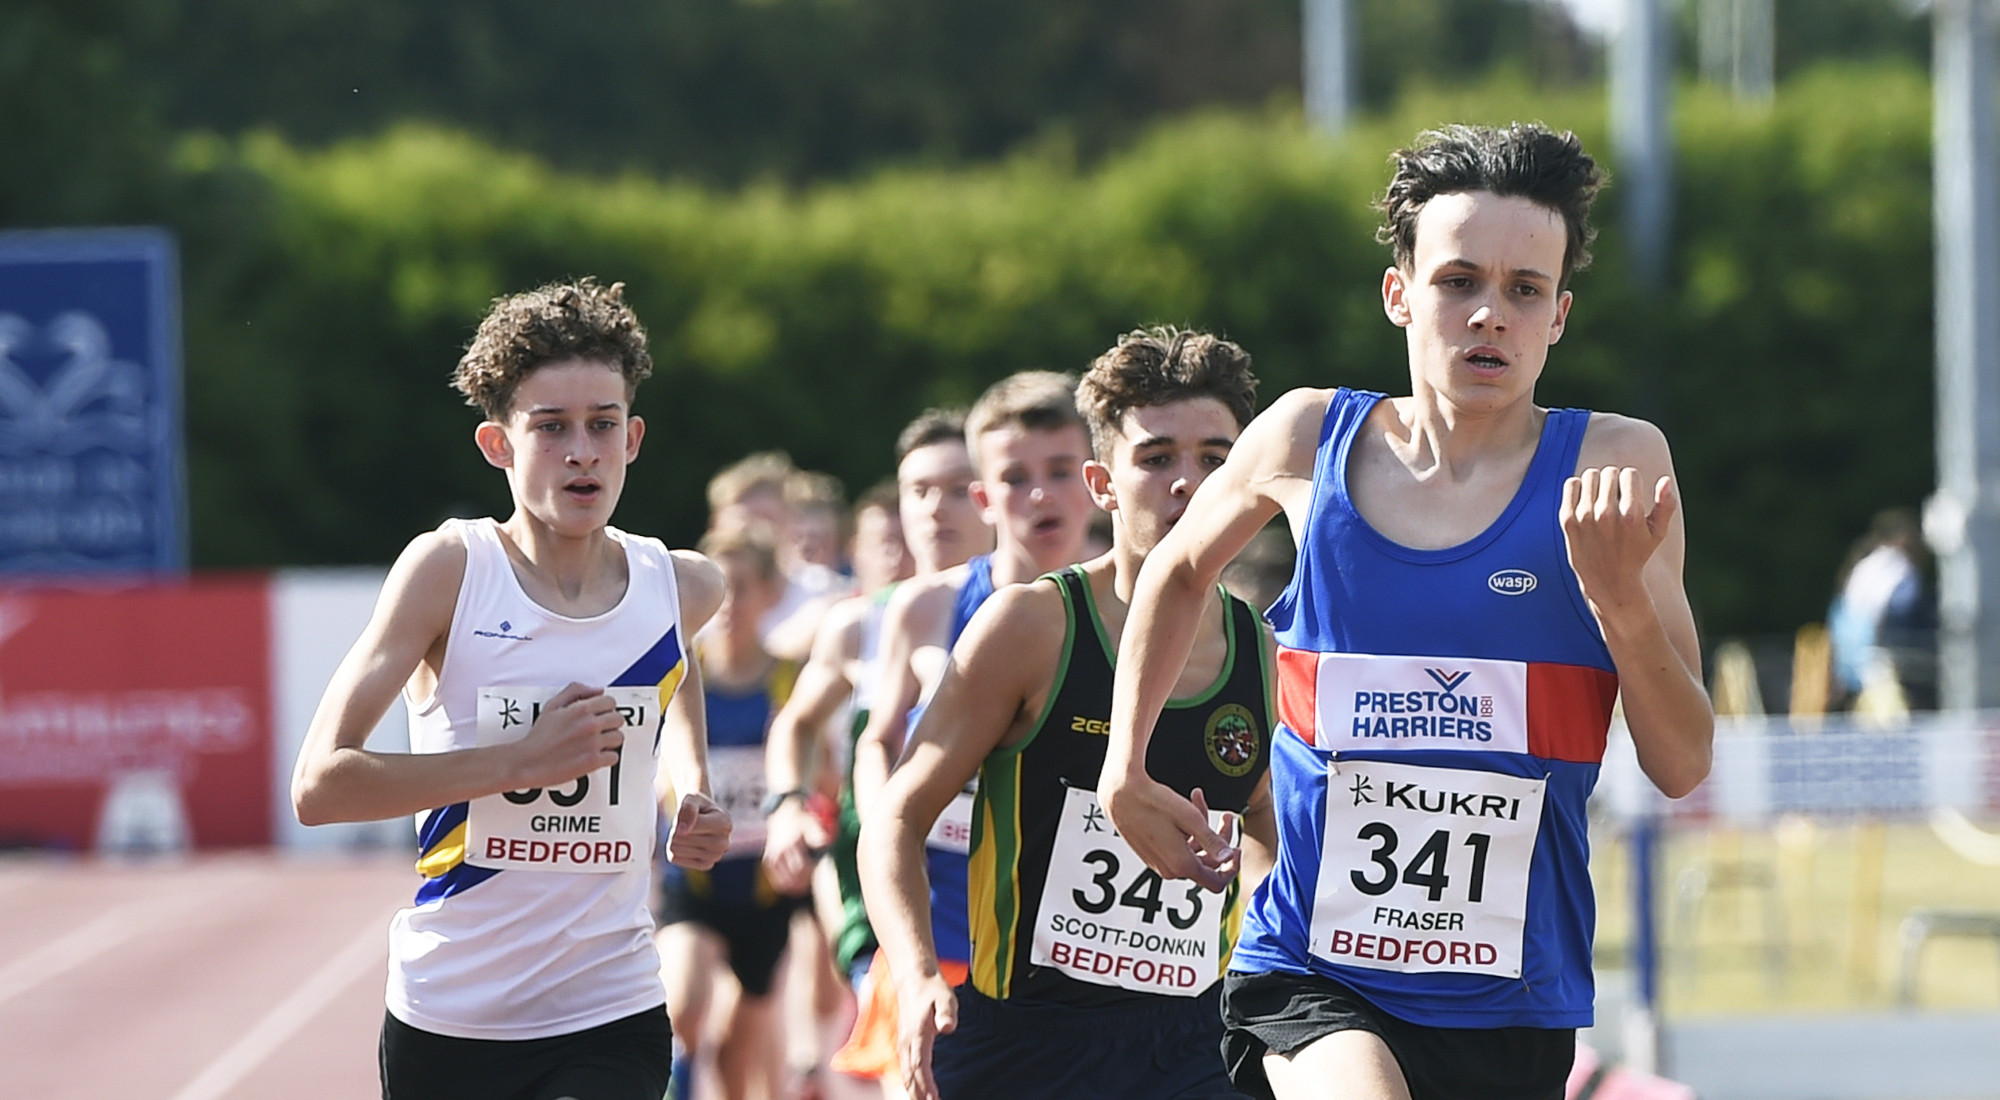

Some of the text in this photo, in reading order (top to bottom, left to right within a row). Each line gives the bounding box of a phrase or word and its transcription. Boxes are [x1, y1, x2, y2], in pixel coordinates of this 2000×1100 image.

[1493, 576, 1533, 592] wasp
[1354, 691, 1478, 716] PRESTON
[1352, 716, 1492, 742] HARRIERS
[1385, 781, 1520, 820] KUKRI
[530, 815, 601, 833] GRIME
[485, 837, 631, 863] BEDFORD
[1350, 822, 1490, 903] 341
[1072, 849, 1202, 930] 343
[1373, 906, 1464, 931] FRASER
[1051, 914, 1206, 957] SCOTT-DONKIN
[1331, 929, 1498, 965] BEDFORD
[1051, 941, 1197, 988] BEDFORD
